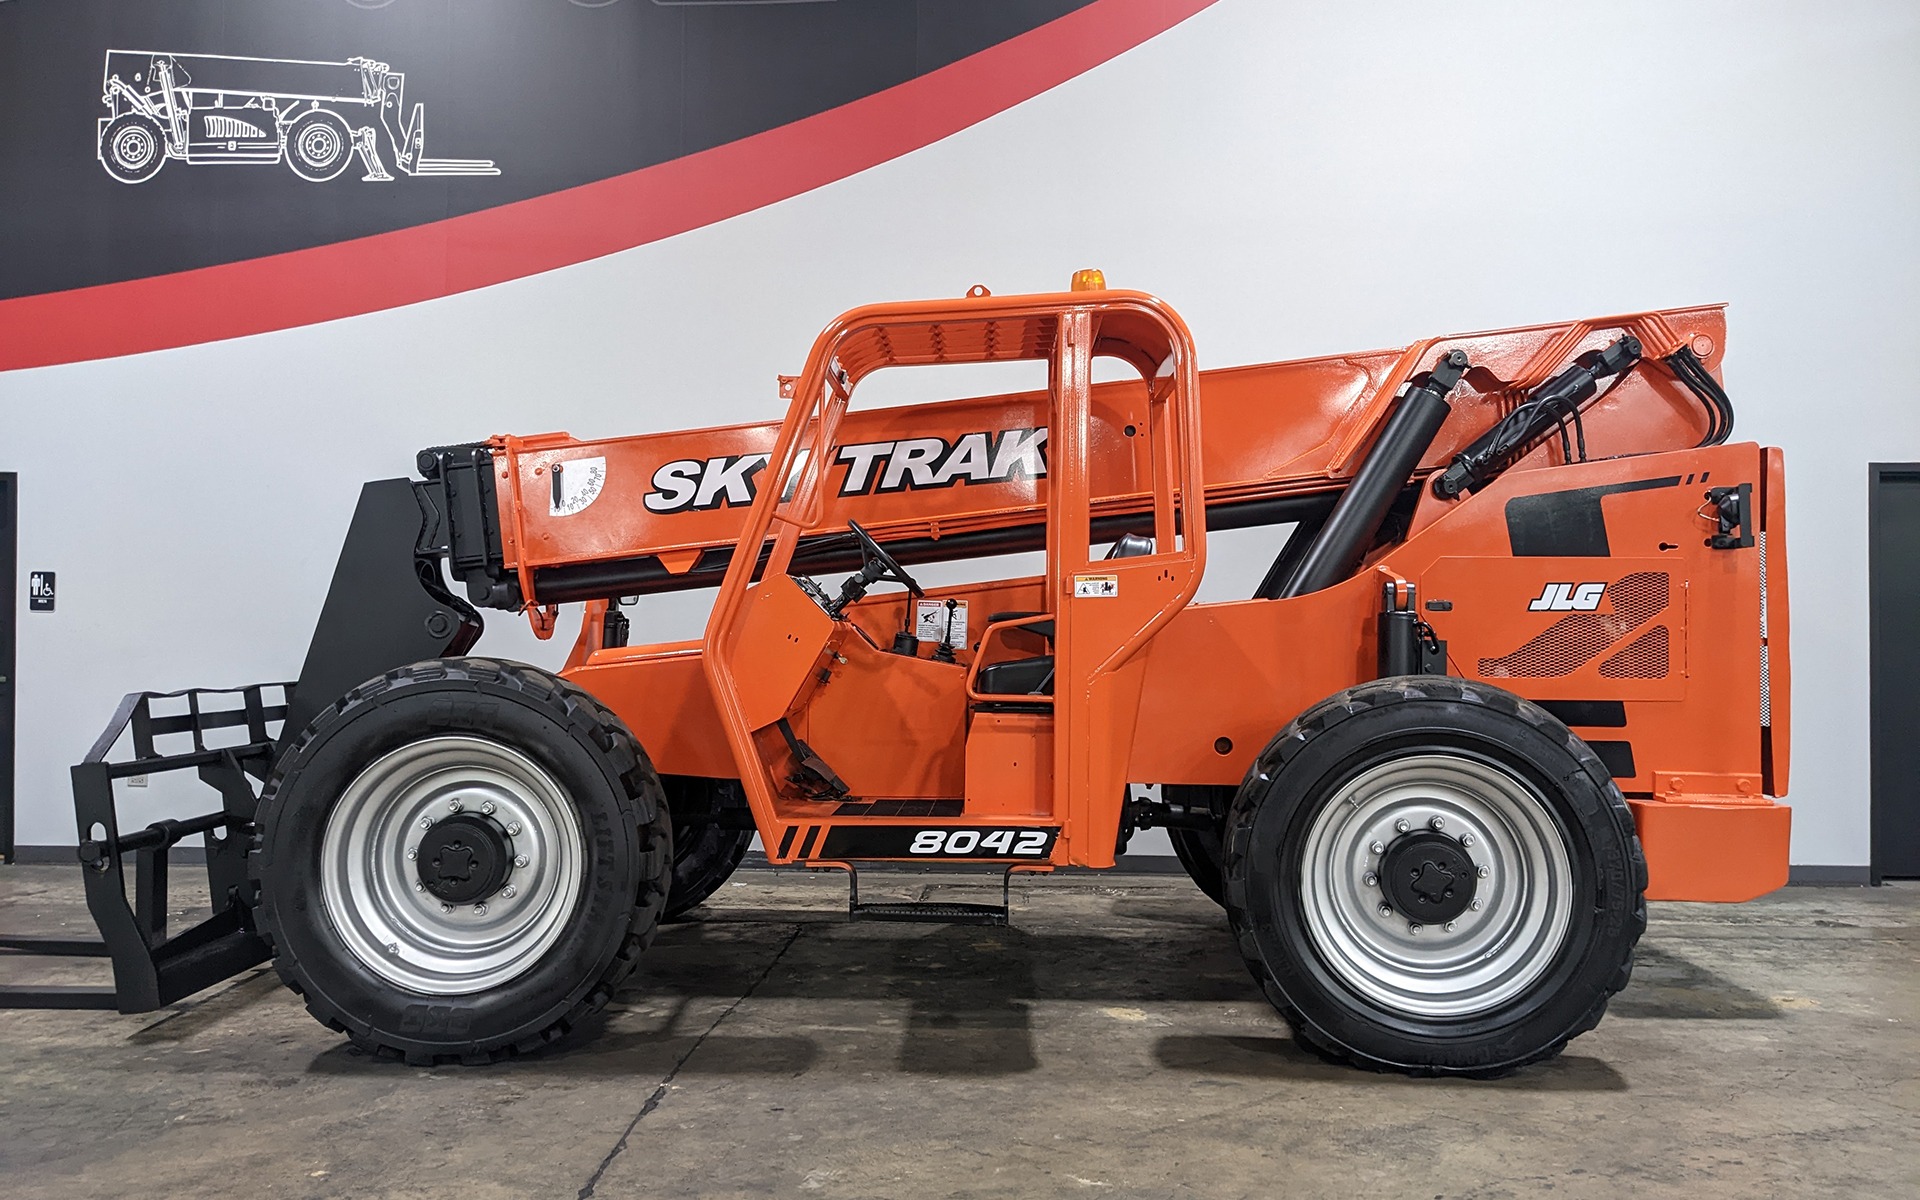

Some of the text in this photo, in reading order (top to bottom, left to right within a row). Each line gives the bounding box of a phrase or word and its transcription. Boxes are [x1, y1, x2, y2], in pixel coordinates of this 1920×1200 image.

[593, 473, 602, 481] 70
[587, 478, 595, 486] 60
[581, 488, 589, 496] 40
[588, 486, 597, 495] 50
[571, 495, 579, 504] 20
[578, 496, 587, 505] 30
[567, 502, 575, 511] 10
[1527, 582, 1607, 611] JLG
[909, 830, 1048, 855] 8042
